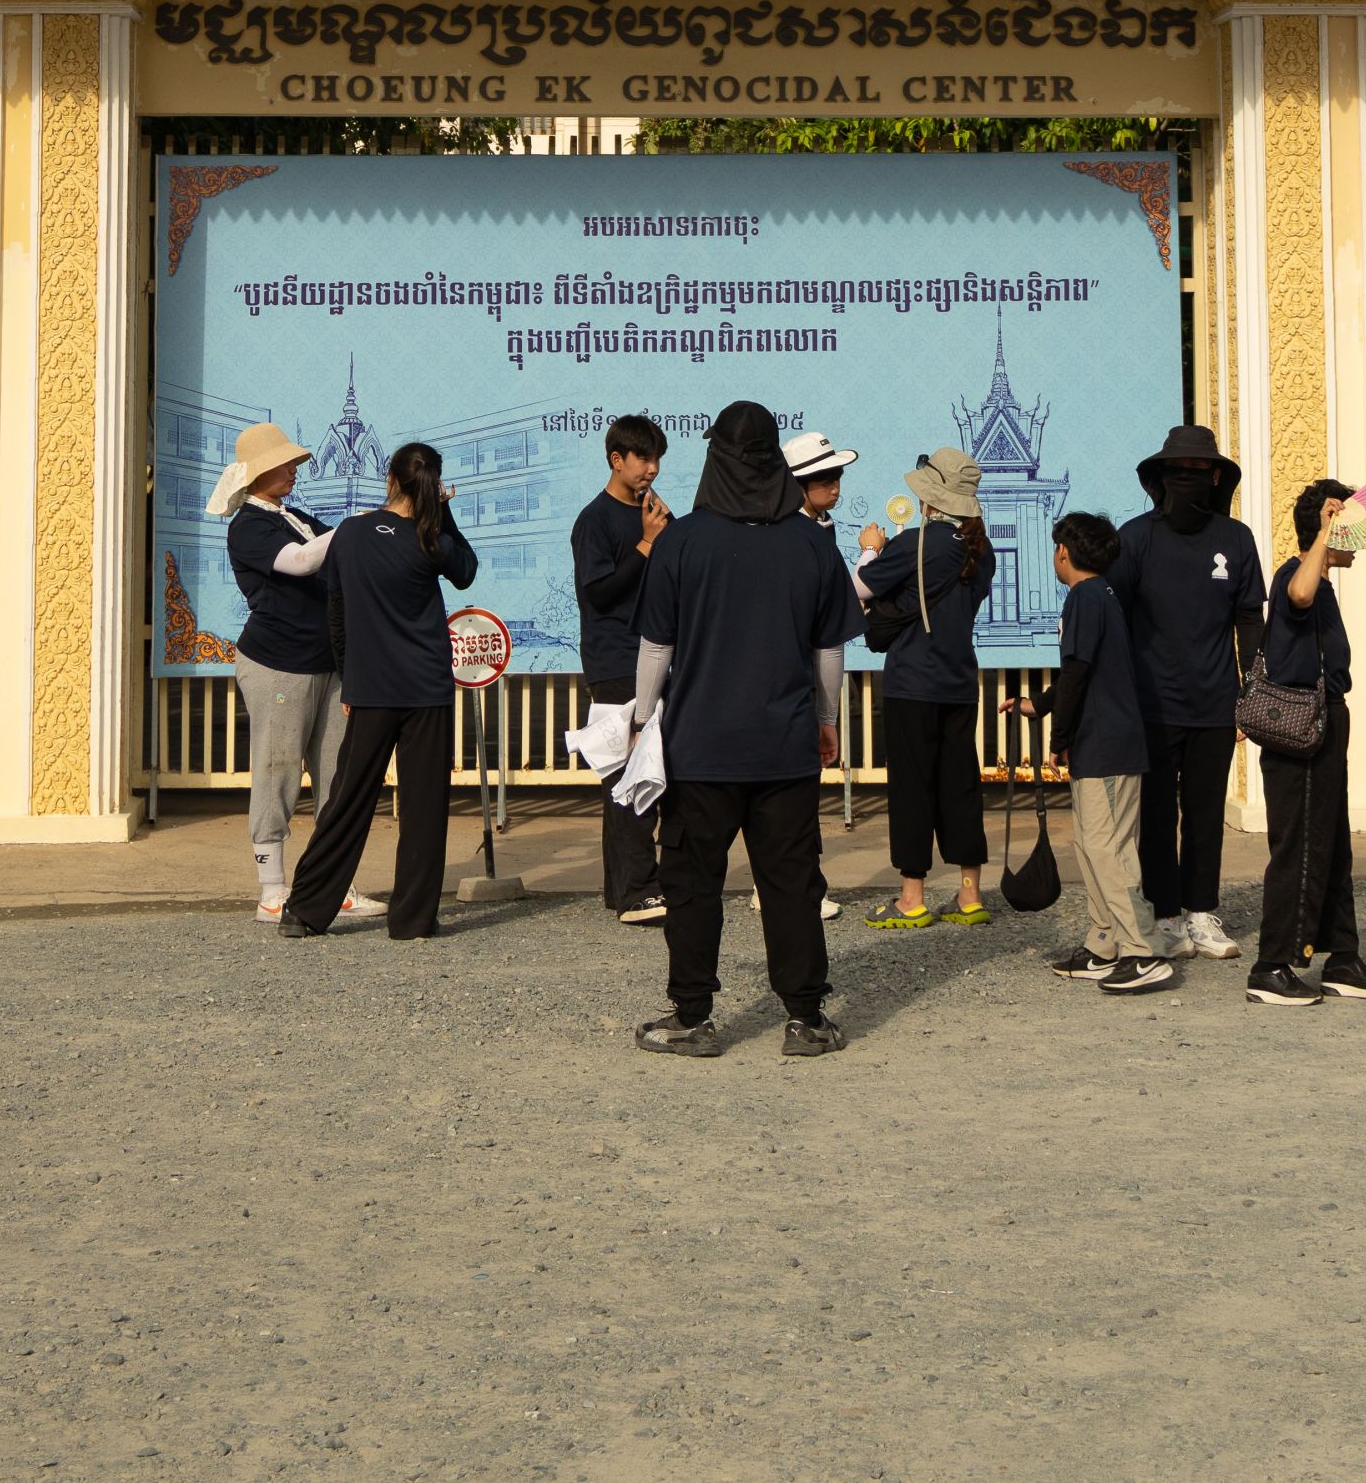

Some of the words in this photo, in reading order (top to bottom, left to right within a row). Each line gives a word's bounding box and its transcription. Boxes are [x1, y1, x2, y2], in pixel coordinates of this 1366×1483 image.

[280, 74, 507, 104] CHOEUNG
[534, 75, 593, 104] EK
[622, 74, 881, 104] GENOCIDAL
[901, 75, 1079, 104] CENTER
[583, 216, 759, 245] អបអរសាទរការចុះ
[507, 321, 837, 371] ក្នុងបញ្ជីបេតិកភណ្ឌពិភពលោក
[462, 653, 503, 667] PARKING
